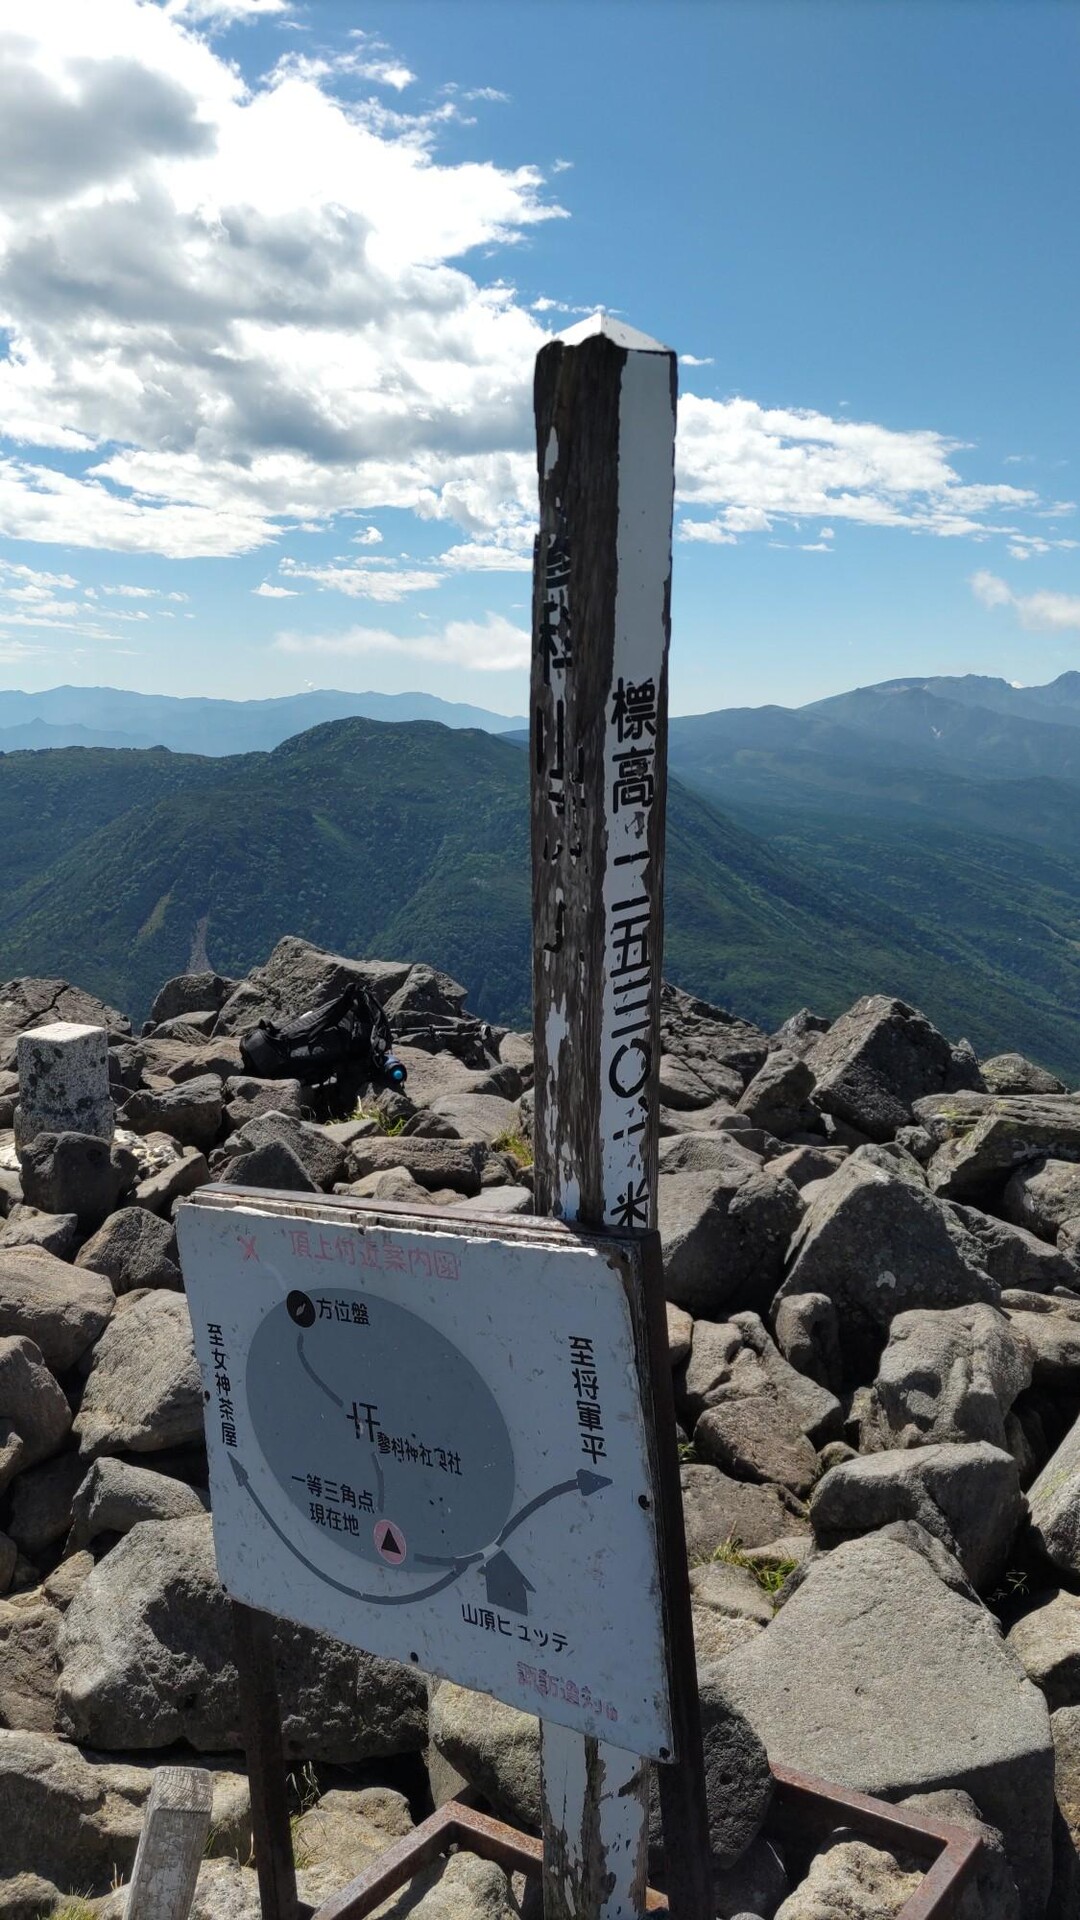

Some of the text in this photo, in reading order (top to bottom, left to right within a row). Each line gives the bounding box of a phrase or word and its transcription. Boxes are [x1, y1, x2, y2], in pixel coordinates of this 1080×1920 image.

[316, 1297, 371, 1327] 方位盤
[207, 1323, 238, 1448] 至女神茶屋
[568, 1335, 607, 1465] 至将軍平
[291, 1472, 375, 1514] 一等三角点
[308, 1501, 360, 1537] 現在地
